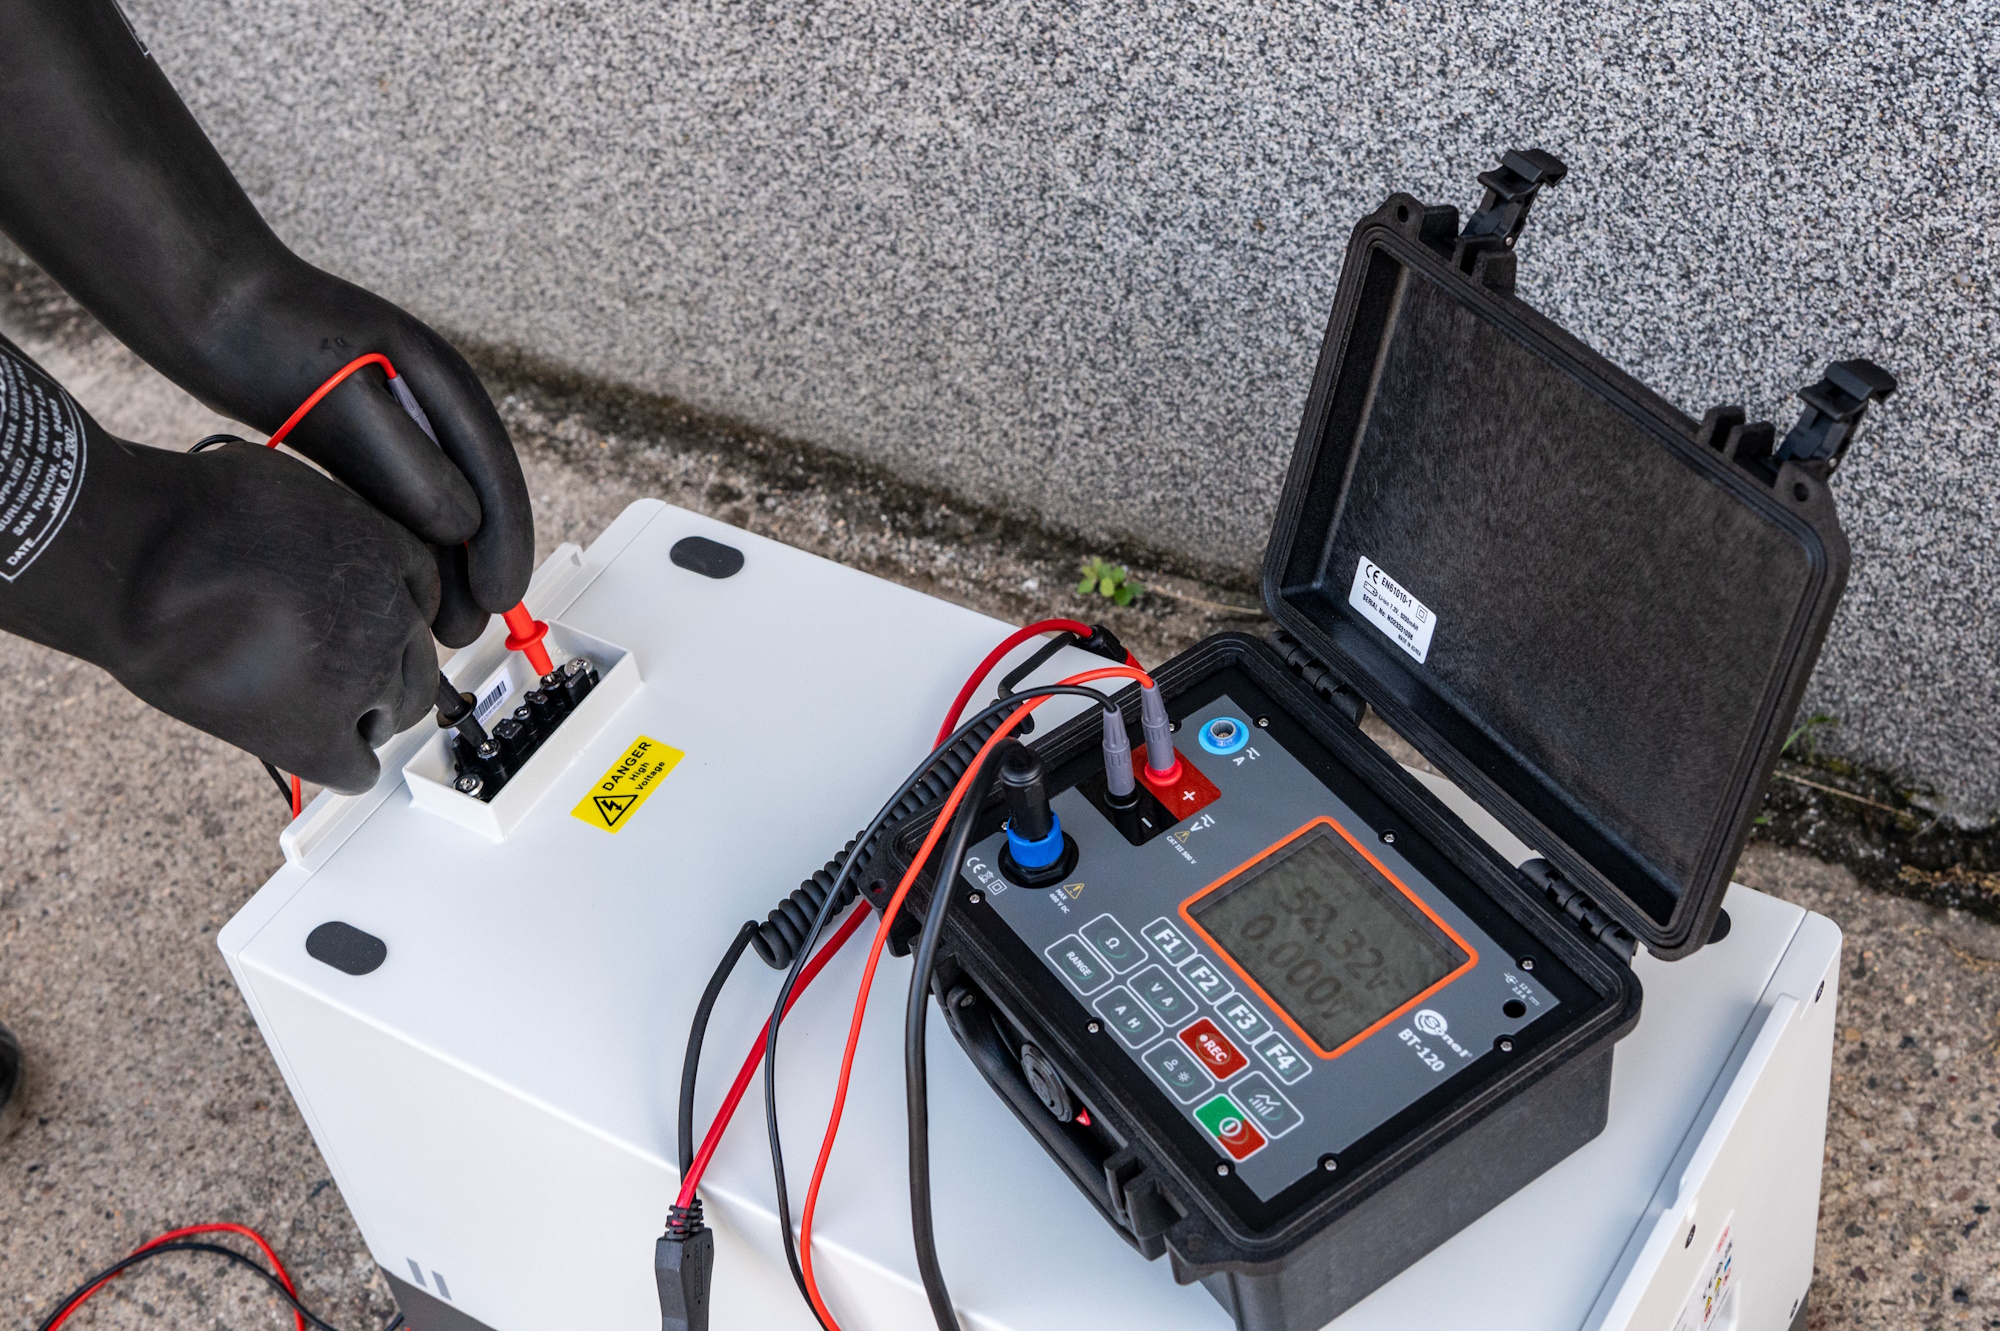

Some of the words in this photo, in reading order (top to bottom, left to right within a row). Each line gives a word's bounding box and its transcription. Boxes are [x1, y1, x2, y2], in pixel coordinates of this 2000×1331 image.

[1, 422, 18, 460] ASTM
[37, 407, 49, 454] SAFETY
[0, 458, 26, 505] PPLIED
[22, 416, 34, 447] MAX
[13, 511, 36, 536] SAN
[32, 463, 61, 511] RAMON,
[52, 440, 63, 458] CA
[6, 537, 34, 566] DATE
[1362, 593, 1378, 611] SERIAL
[1381, 577, 1412, 608] EN61010-1
[1398, 633, 1407, 644] MADE
[602, 742, 652, 791] DANGER
[629, 762, 650, 781] High
[635, 762, 665, 790] Voltage
[1166, 836, 1178, 845] CAT
[1055, 889, 1068, 900] MAX
[1154, 928, 1180, 954] F1
[1066, 951, 1092, 977] RANGE
[1190, 965, 1220, 993] F2
[1161, 997, 1174, 1007] A
[1115, 1005, 1126, 1015] A
[1127, 1017, 1140, 1029] H
[1227, 1004, 1257, 1030] F3
[1203, 1039, 1228, 1063] REC
[1264, 1042, 1297, 1071] F4
[1398, 1028, 1445, 1072] BT-120
